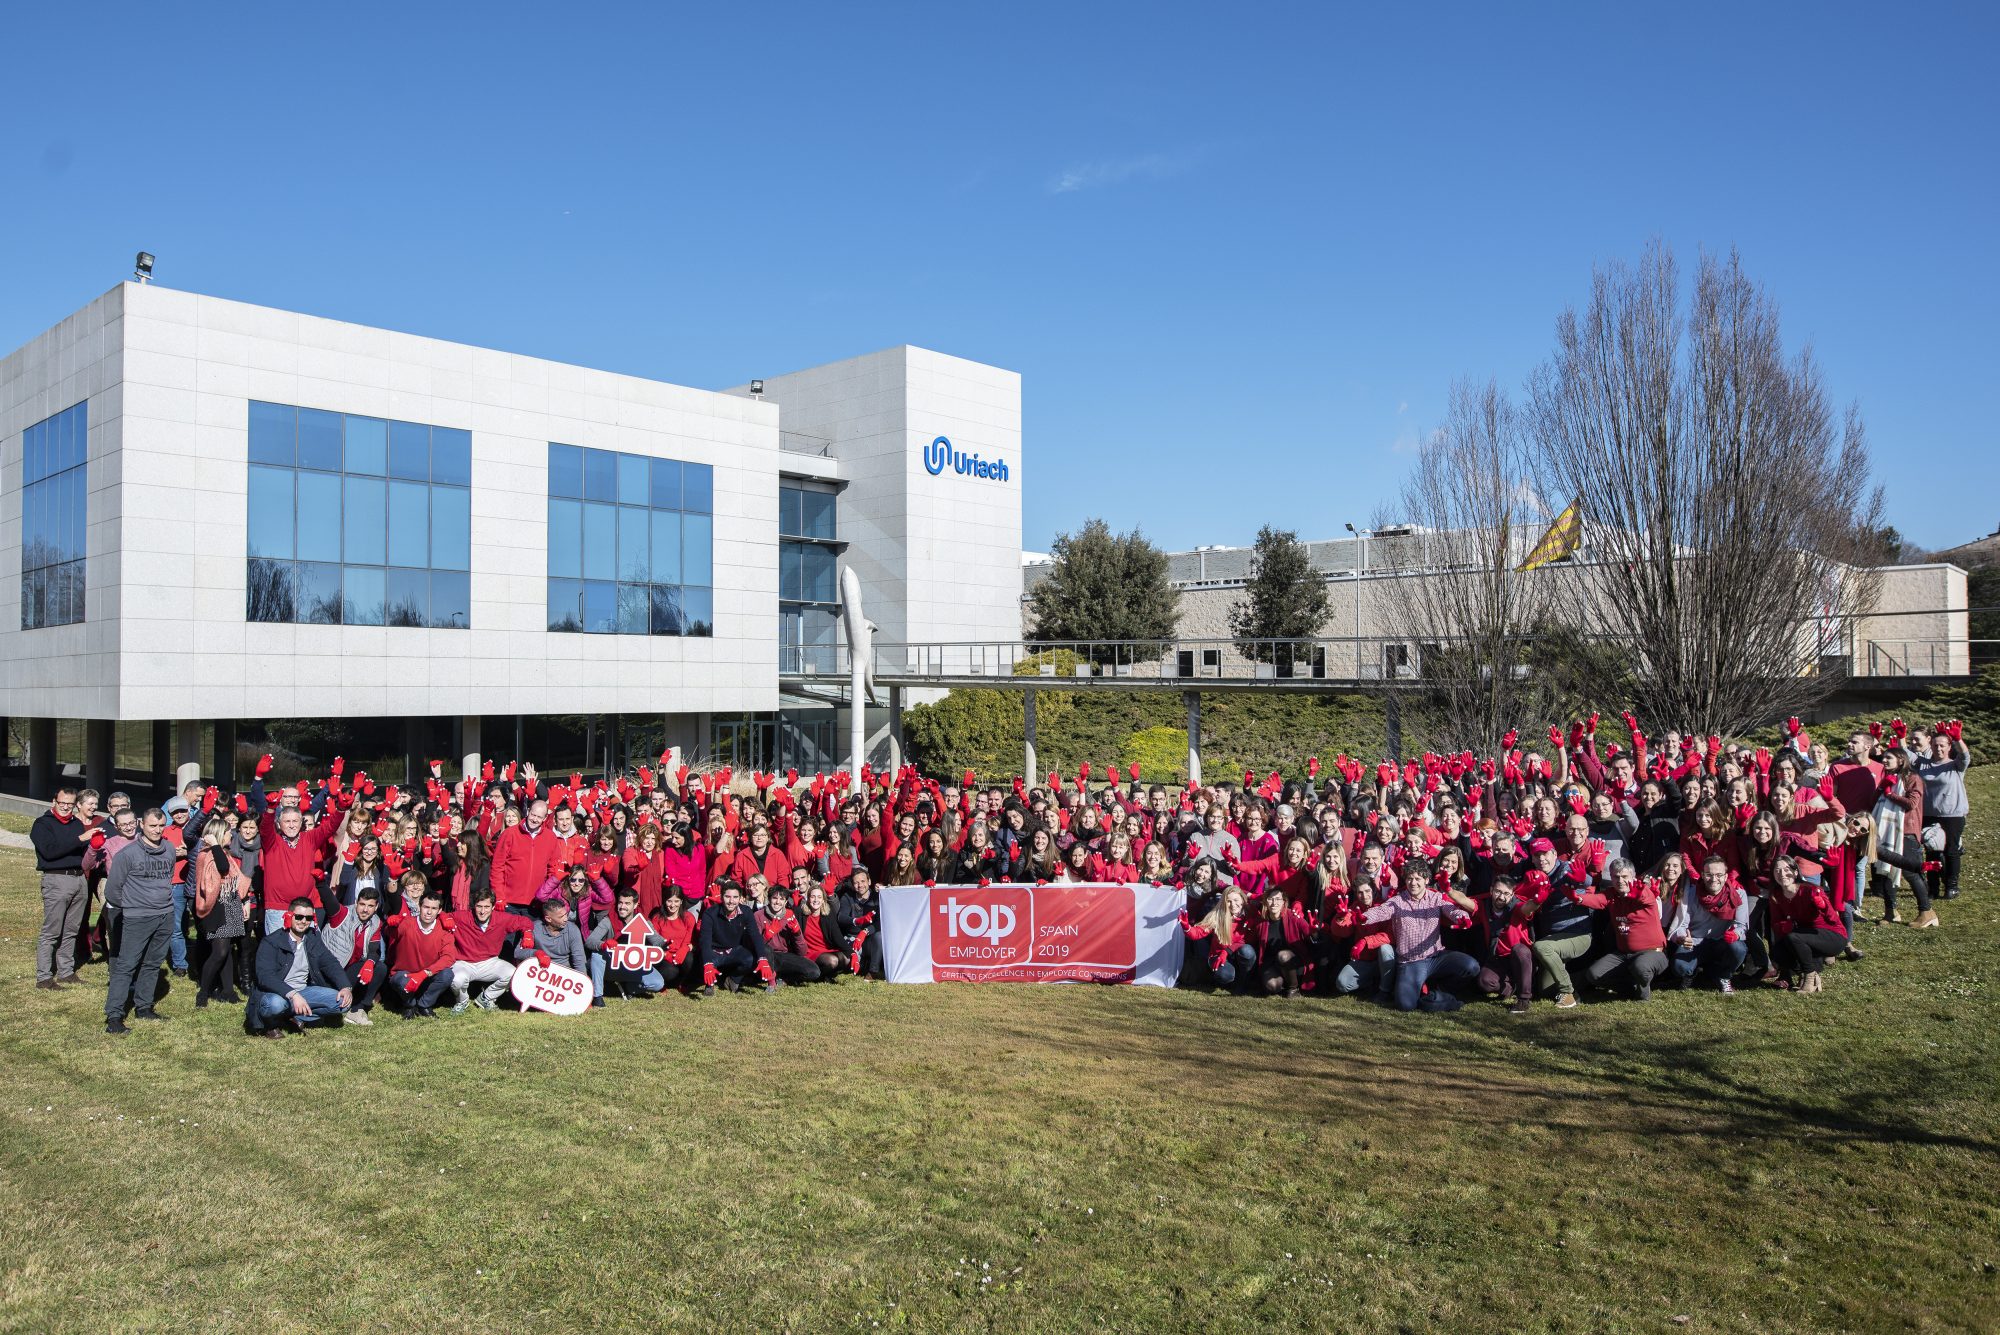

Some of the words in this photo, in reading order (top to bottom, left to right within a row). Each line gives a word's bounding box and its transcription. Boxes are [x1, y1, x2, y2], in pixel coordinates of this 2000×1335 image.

[954, 451, 1009, 482] Uriach
[940, 897, 1016, 945] top
[1040, 925, 1079, 937] SPAIN
[609, 945, 664, 970] TOP
[949, 946, 1016, 959] EMPLOYER
[1038, 945, 1070, 957] 2019
[527, 965, 584, 995] SOMOS
[941, 971, 977, 980] CERTIFED
[1037, 969, 1077, 977] EMPLOYEE
[534, 985, 566, 1005] TOP
